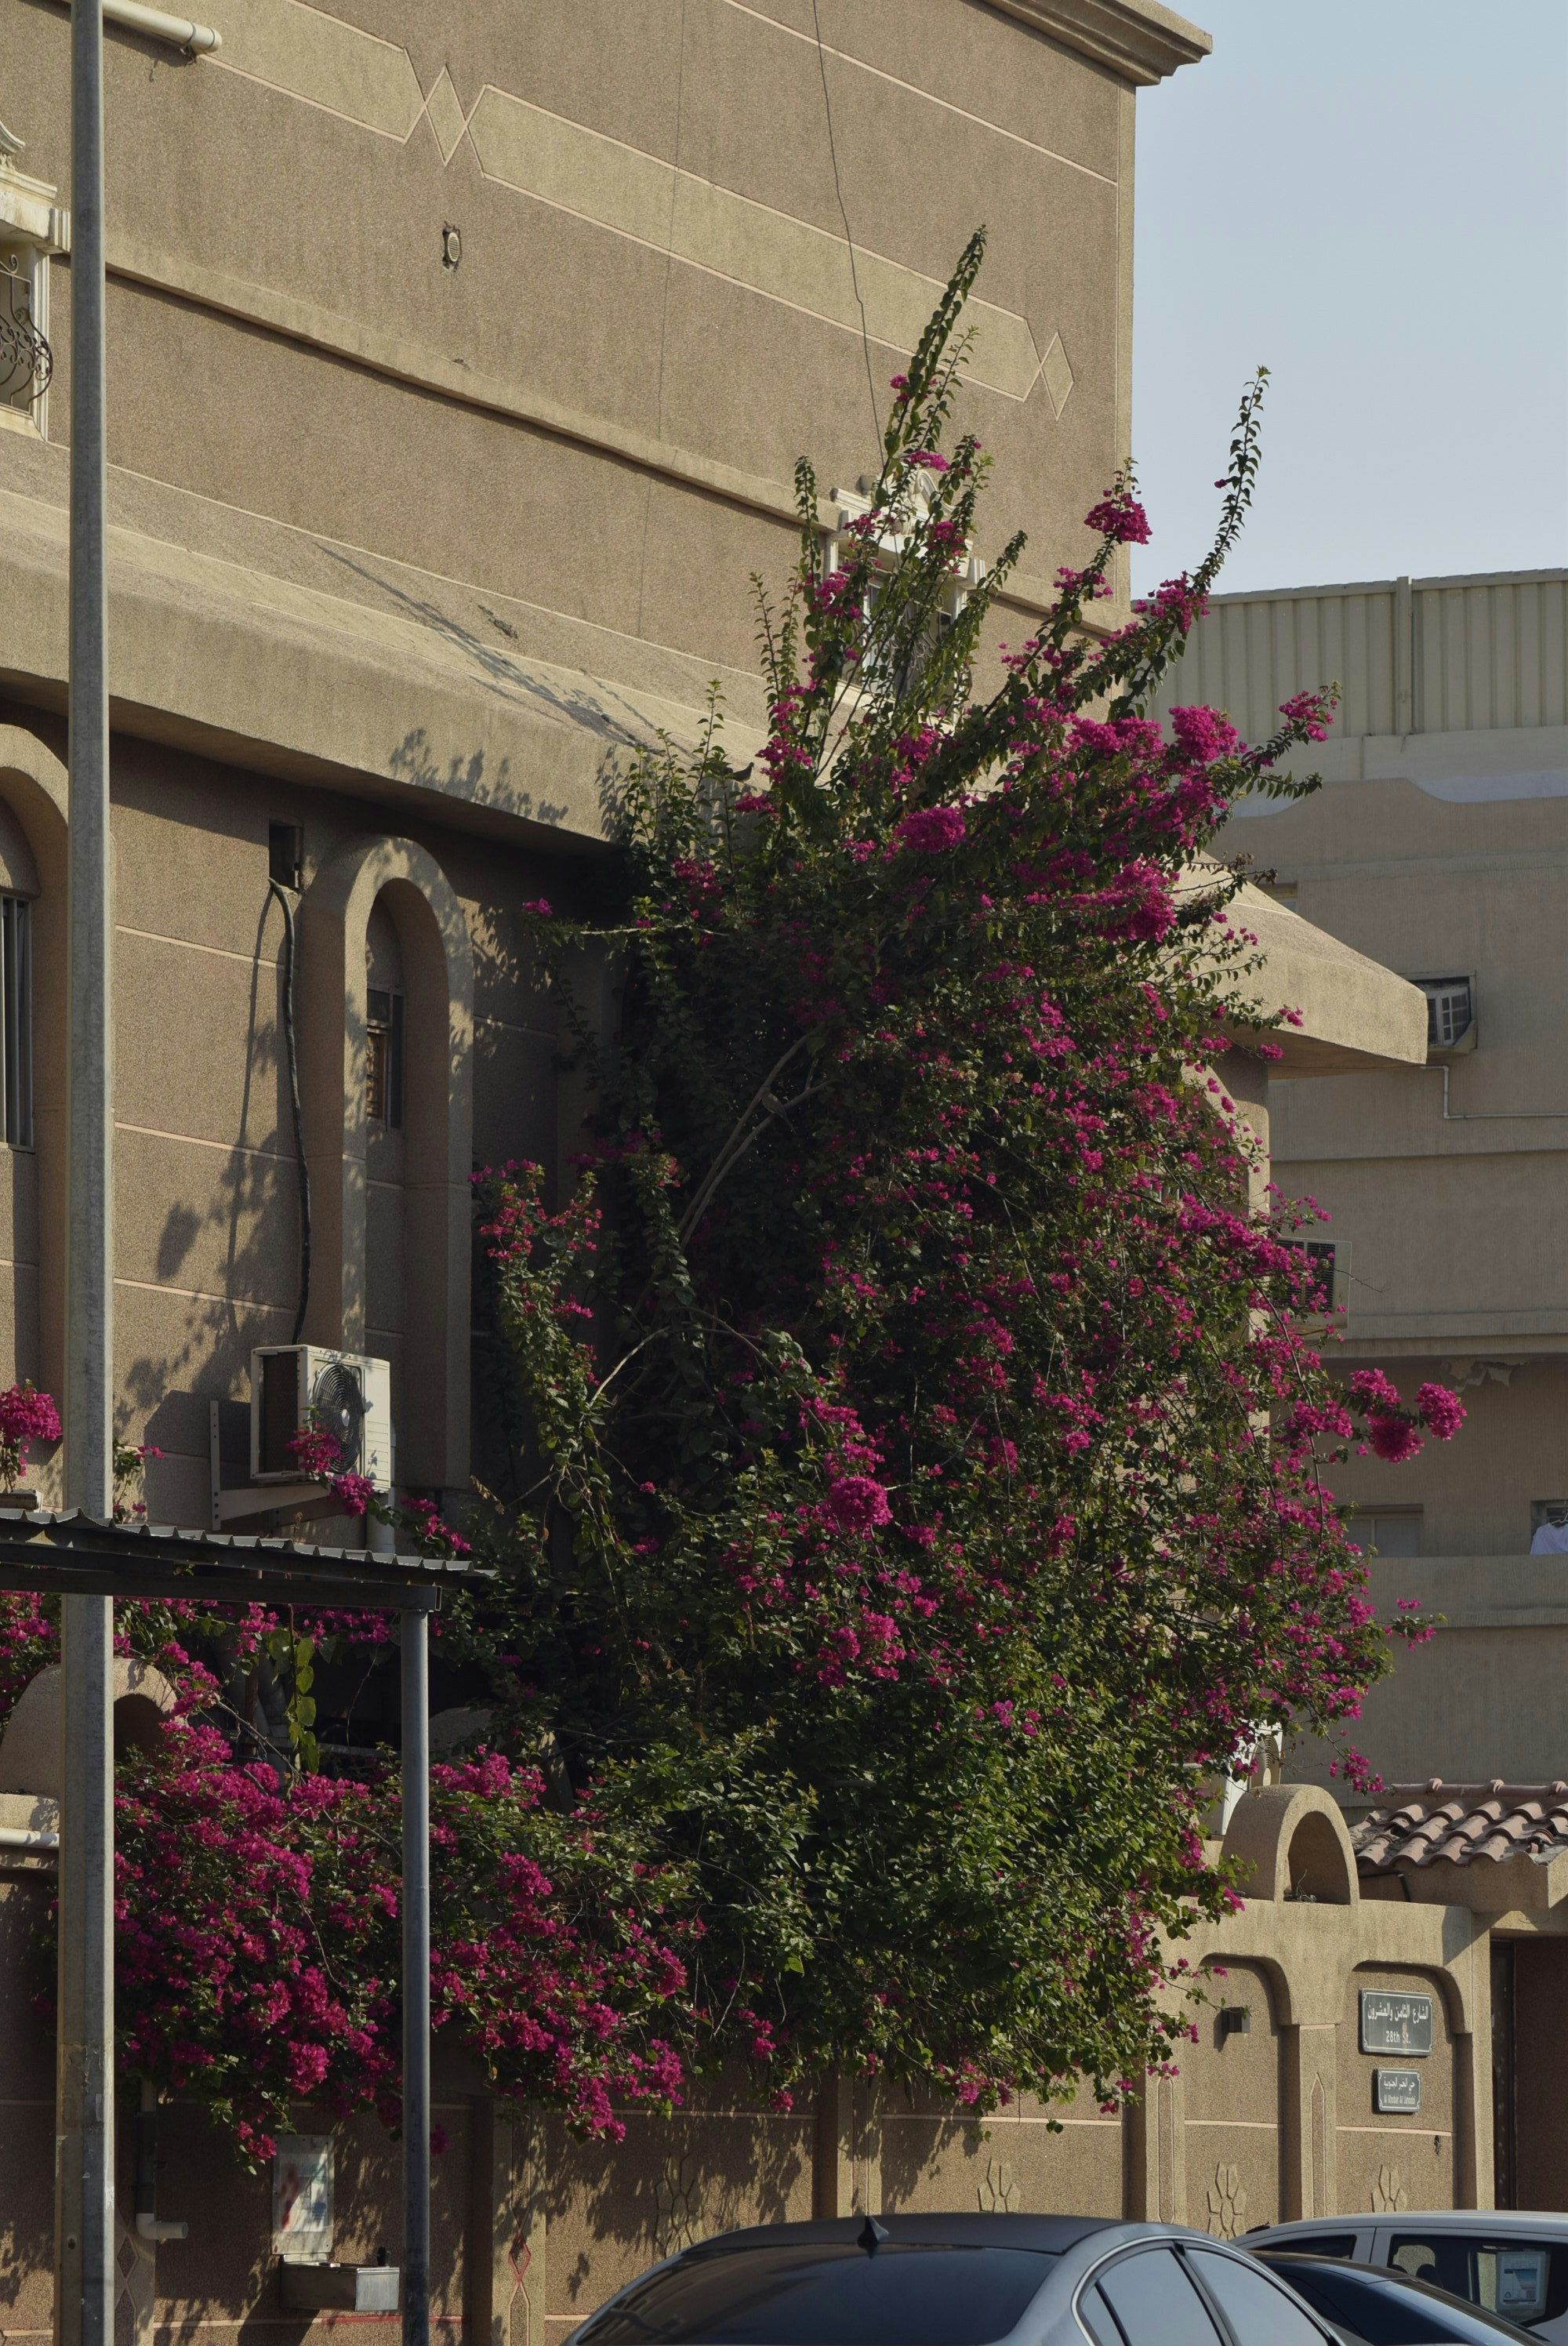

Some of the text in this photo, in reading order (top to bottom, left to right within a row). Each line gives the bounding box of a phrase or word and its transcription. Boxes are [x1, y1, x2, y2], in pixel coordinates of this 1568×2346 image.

[1367, 2002, 1428, 2024] الشارع الثامن والعشرون
[1385, 2030, 1411, 2044] 28th St.
[1398, 2077, 1407, 2090] الخبر
[1408, 2082, 1415, 2094] حي
